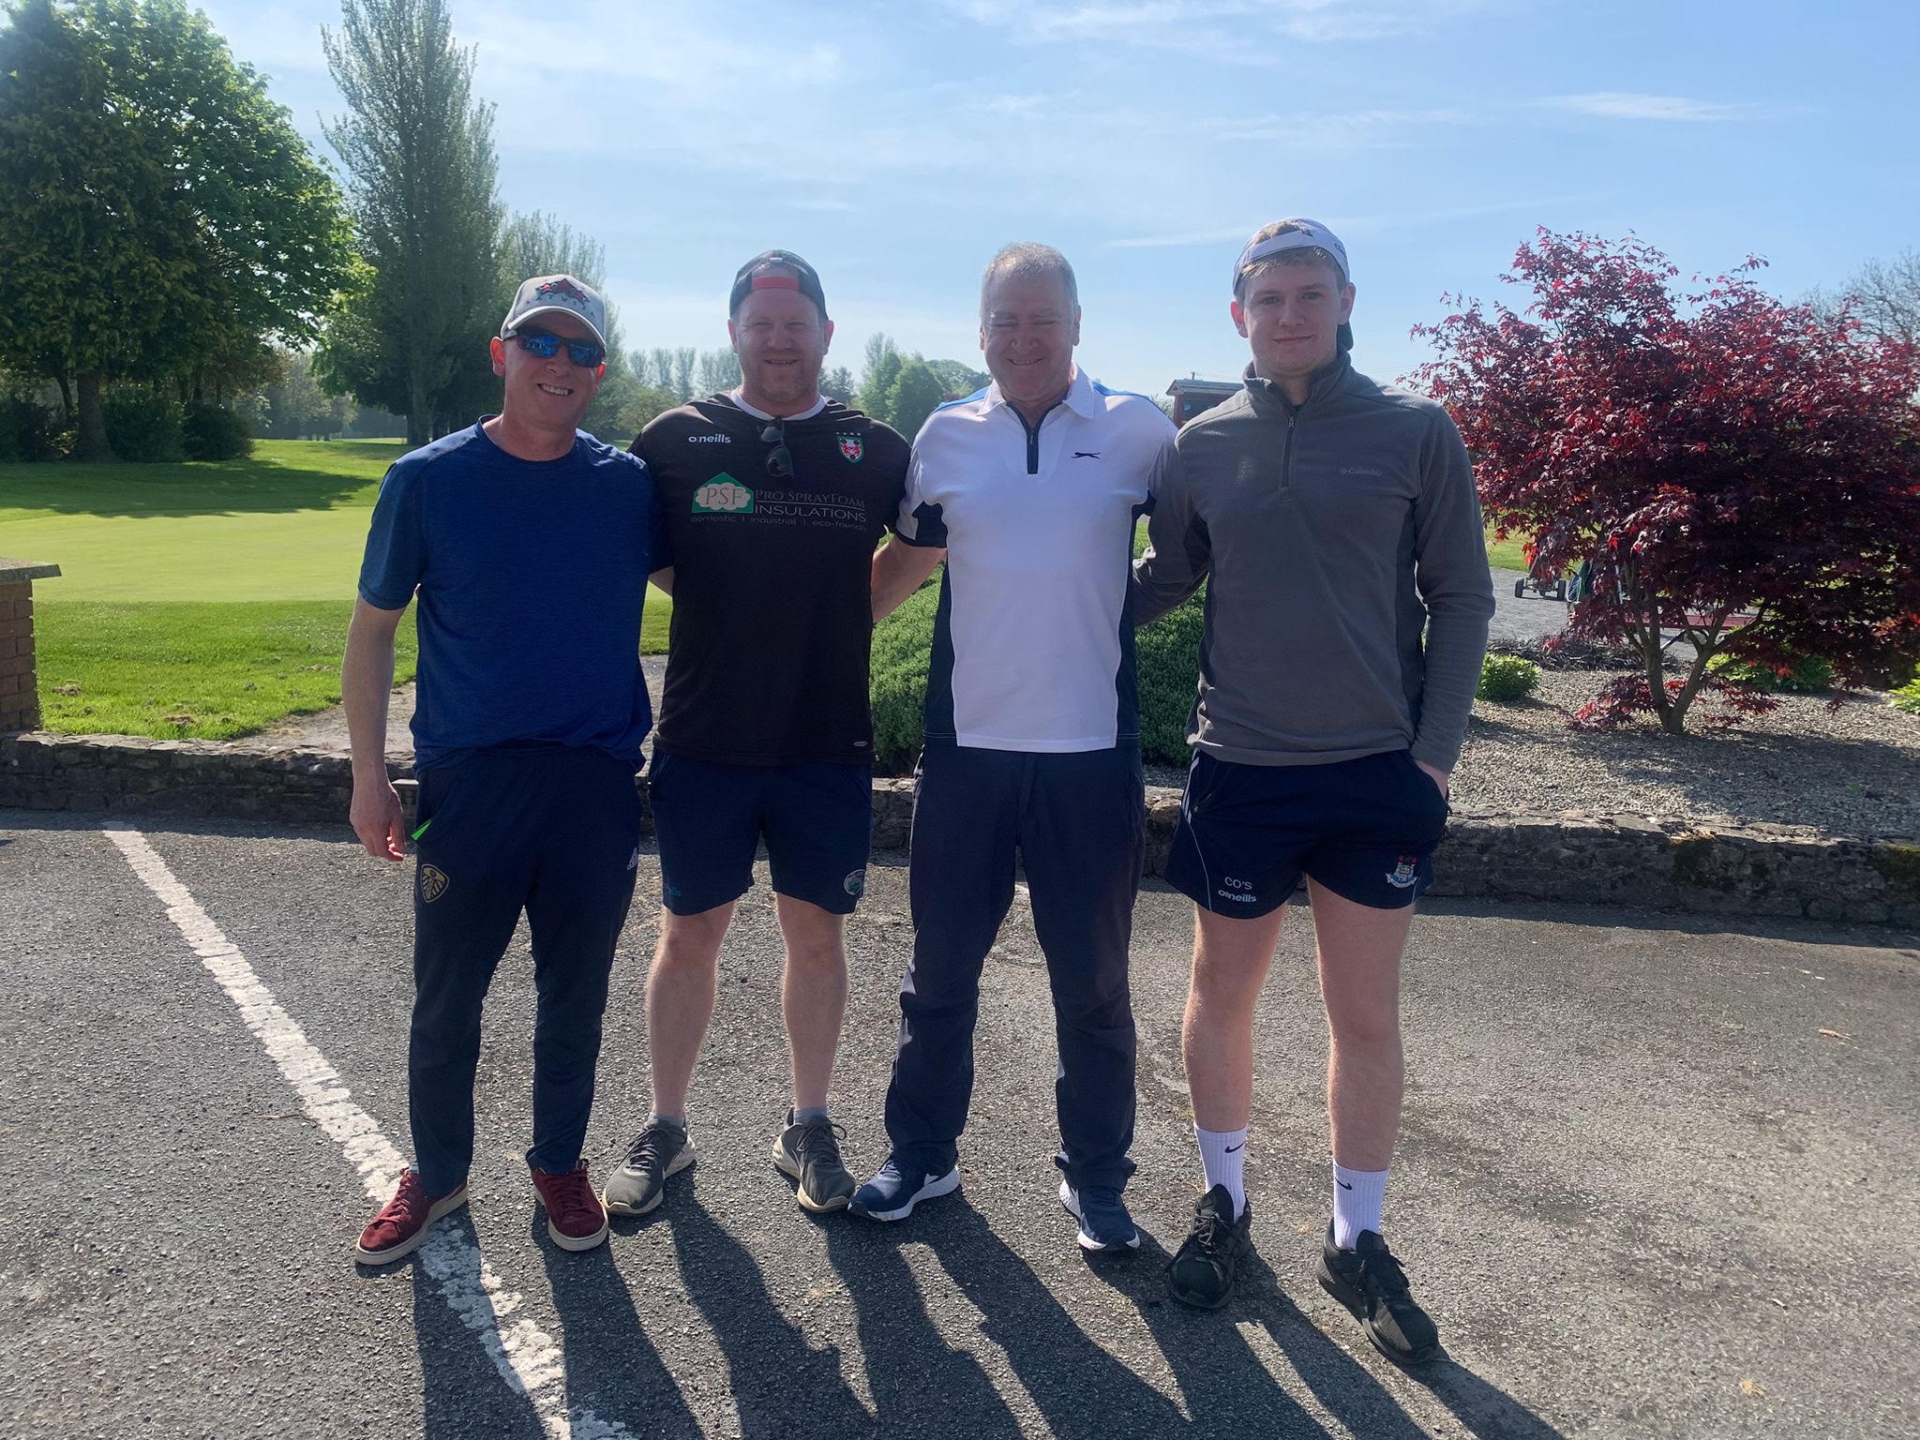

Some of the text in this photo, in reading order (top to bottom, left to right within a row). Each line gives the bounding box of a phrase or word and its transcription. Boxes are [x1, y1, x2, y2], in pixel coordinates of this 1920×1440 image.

[1348, 465, 1382, 477] Colu
[705, 486, 743, 505] PSF
[755, 489, 784, 501] PRO
[755, 505, 867, 523] INSULATIONS
